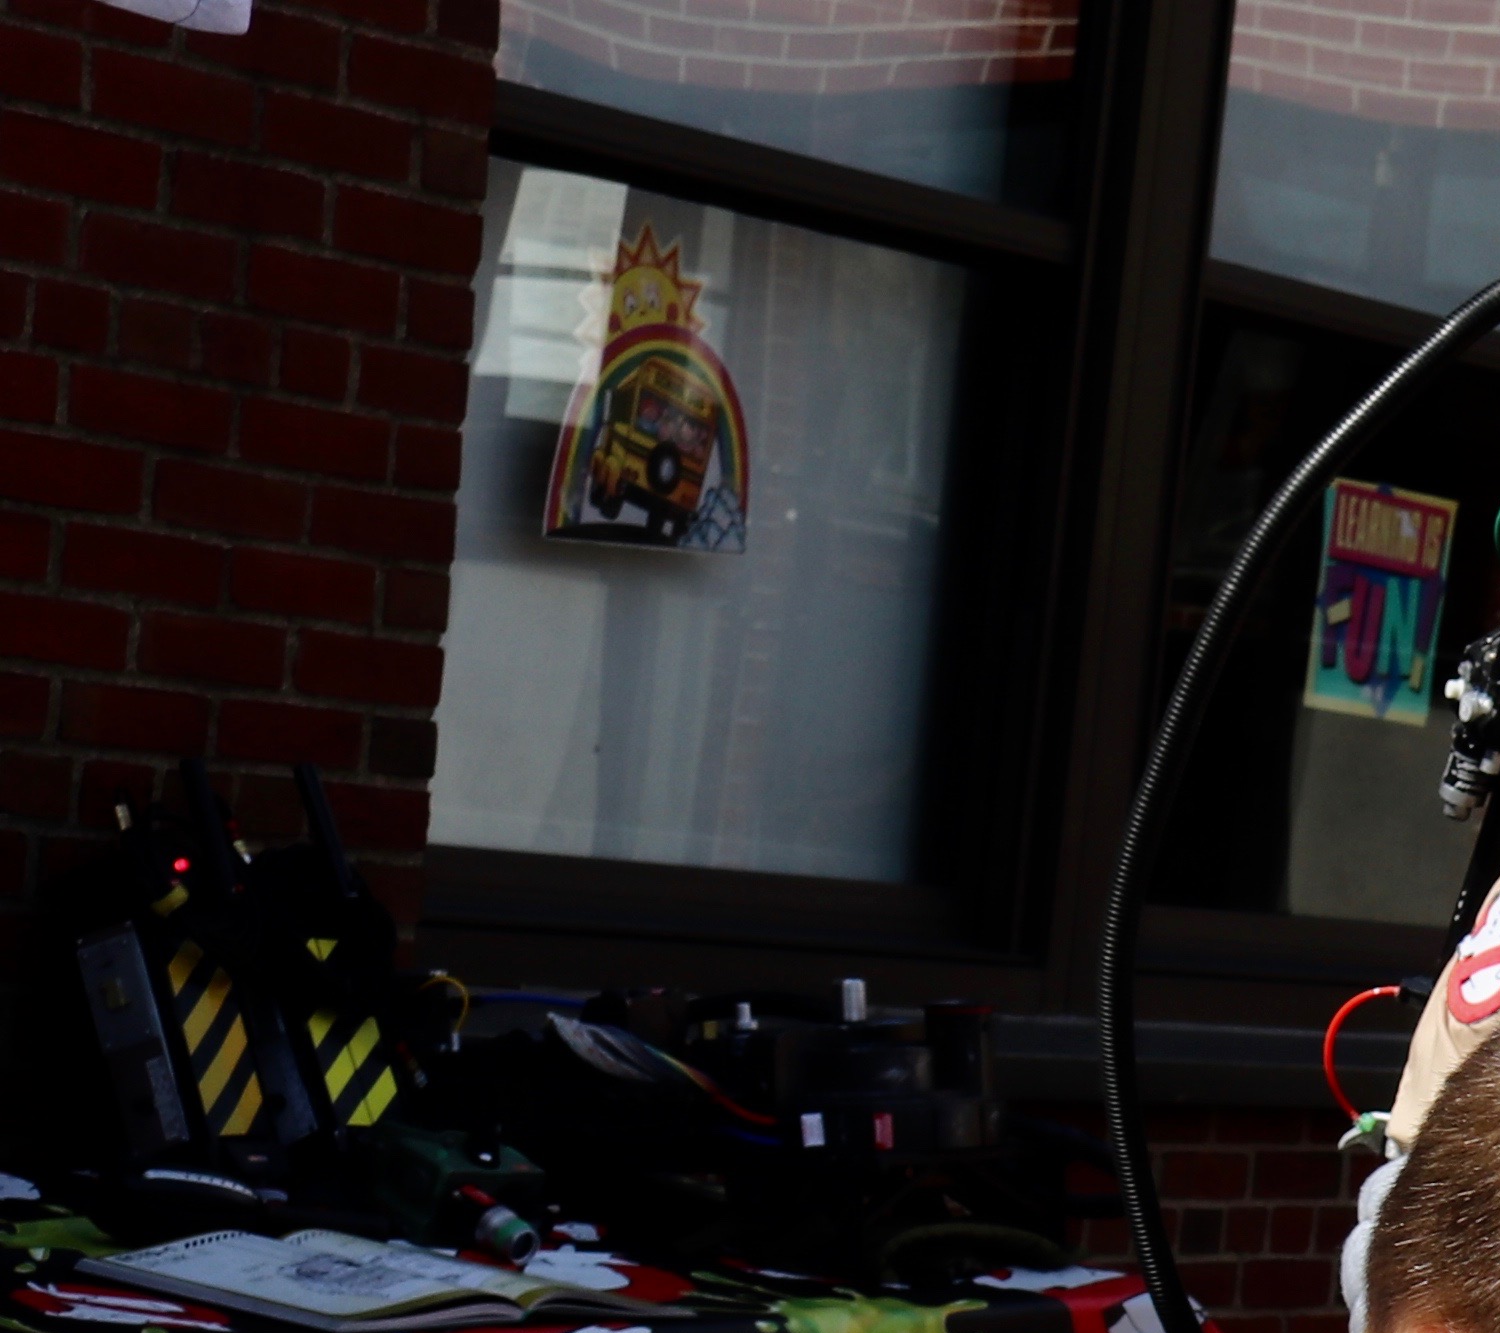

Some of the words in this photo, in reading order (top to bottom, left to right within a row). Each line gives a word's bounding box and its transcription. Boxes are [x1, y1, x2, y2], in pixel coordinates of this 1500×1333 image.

[1336, 493, 1422, 564] LEARNING
[1421, 512, 1446, 570] IS
[1321, 563, 1442, 693] FUN!
